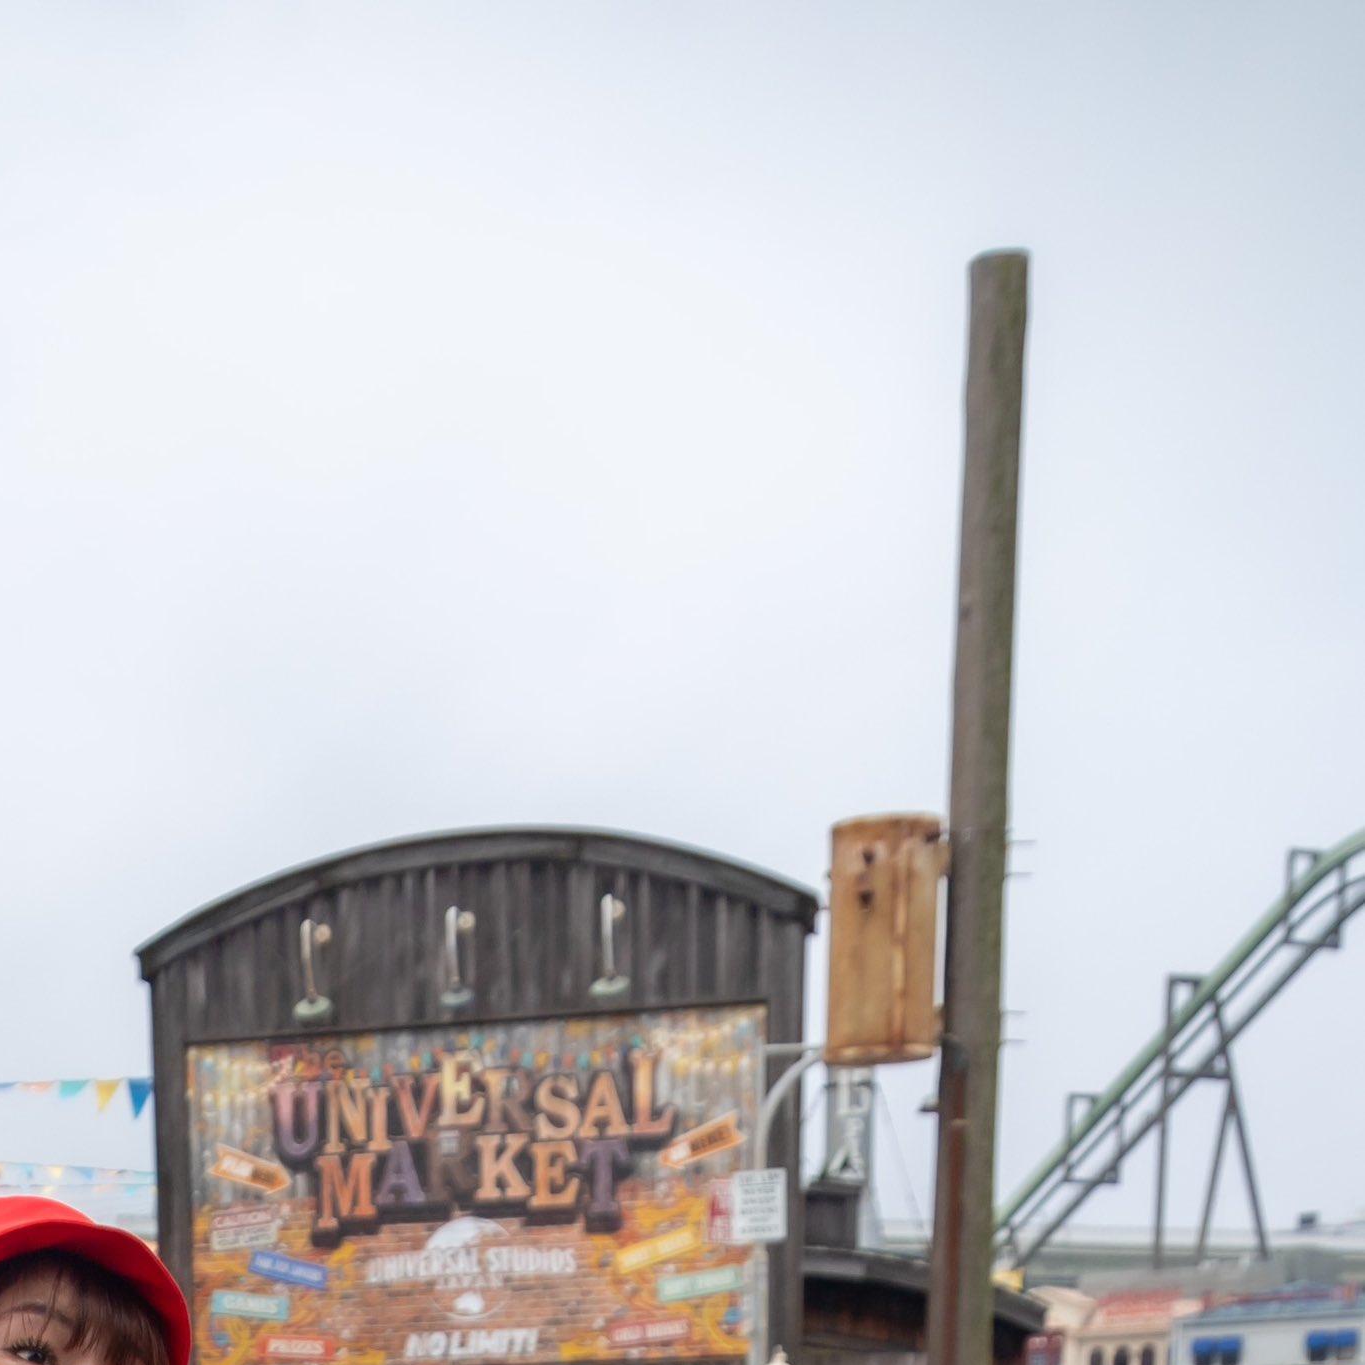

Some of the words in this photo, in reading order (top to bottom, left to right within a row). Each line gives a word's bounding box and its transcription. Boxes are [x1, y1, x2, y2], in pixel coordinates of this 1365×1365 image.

[271, 1049, 675, 1158] UNIVERSAL
[316, 1131, 630, 1231] MARKET
[365, 1248, 482, 1285] UNIVERSAL
[487, 1247, 578, 1274] STUDIOS
[404, 1331, 448, 1360] NO
[449, 1328, 540, 1357] LIMIT!
